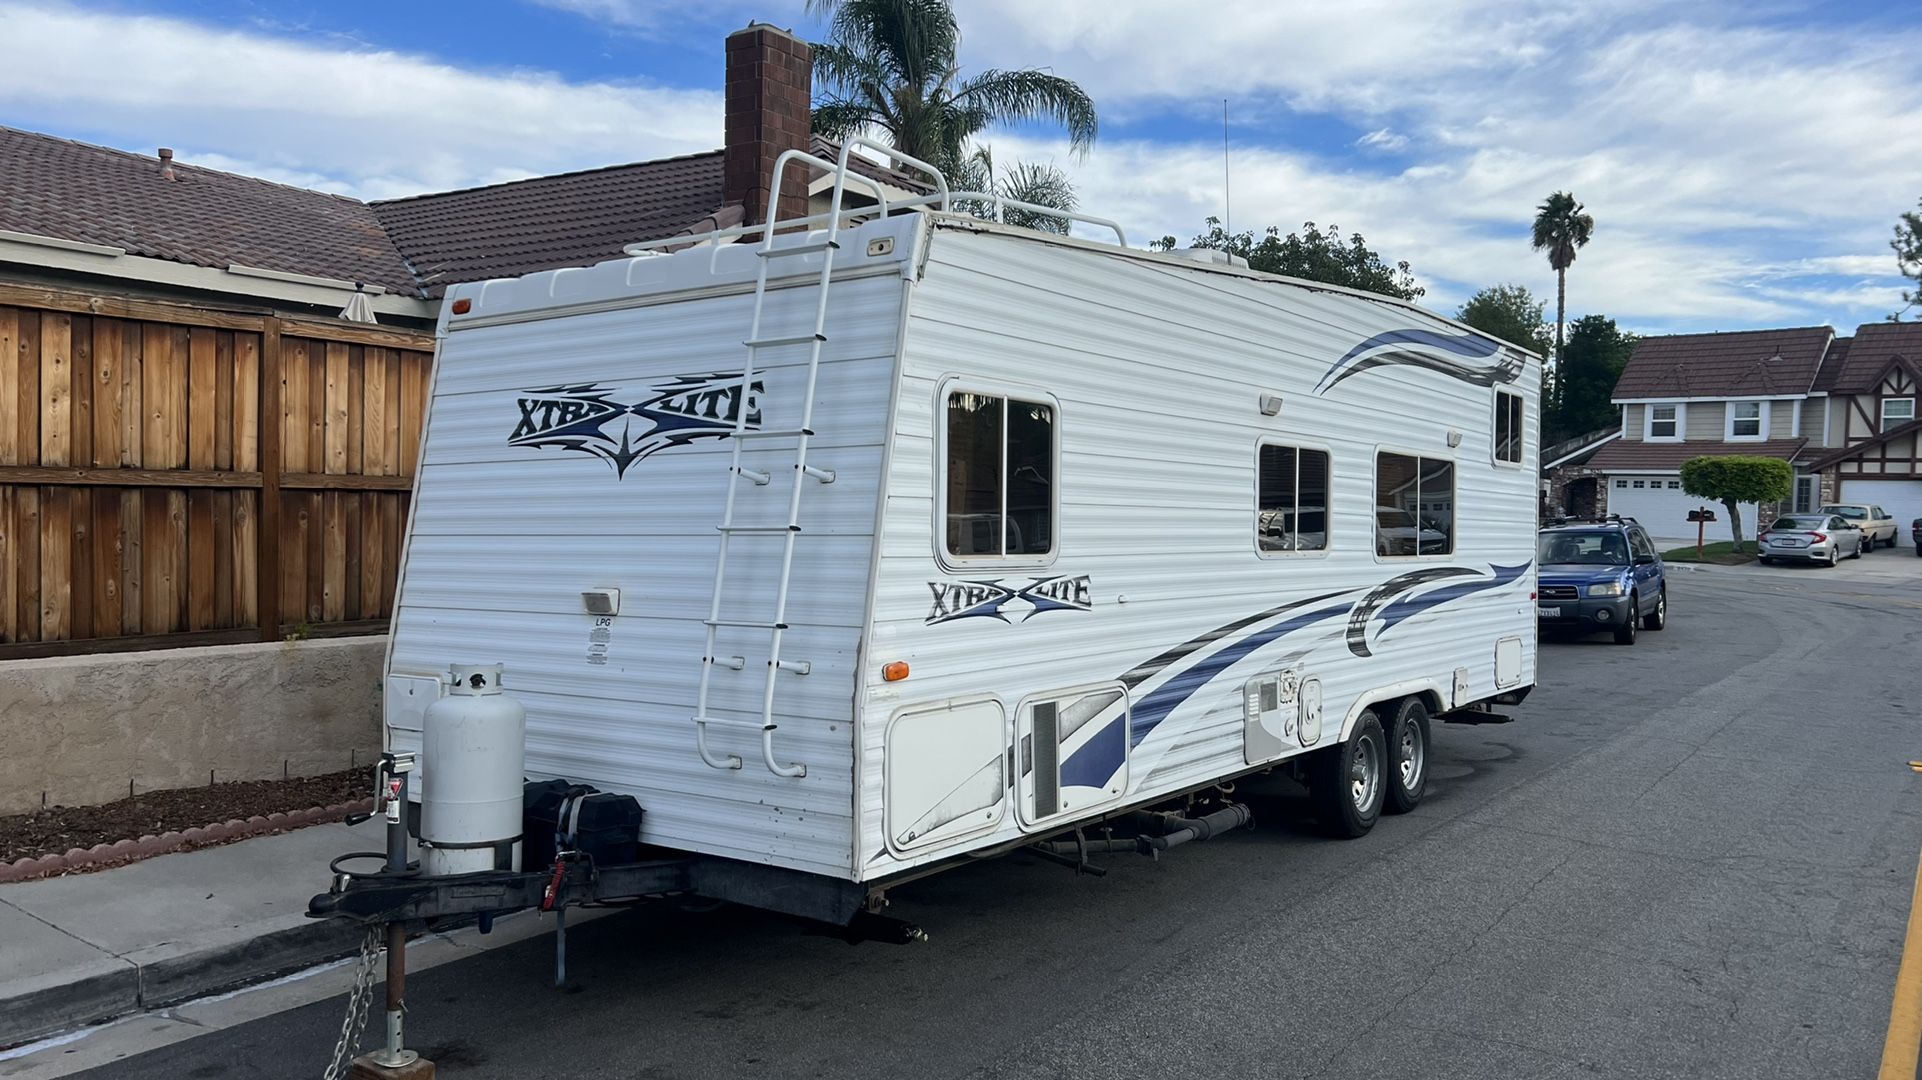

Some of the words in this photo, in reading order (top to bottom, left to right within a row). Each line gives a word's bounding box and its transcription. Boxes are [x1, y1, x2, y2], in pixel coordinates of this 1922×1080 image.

[507, 398, 611, 441] XTRA
[659, 380, 765, 426] LITE
[924, 581, 1003, 622] XTRA
[1036, 575, 1092, 608] LITE
[595, 618, 611, 627] LPG
